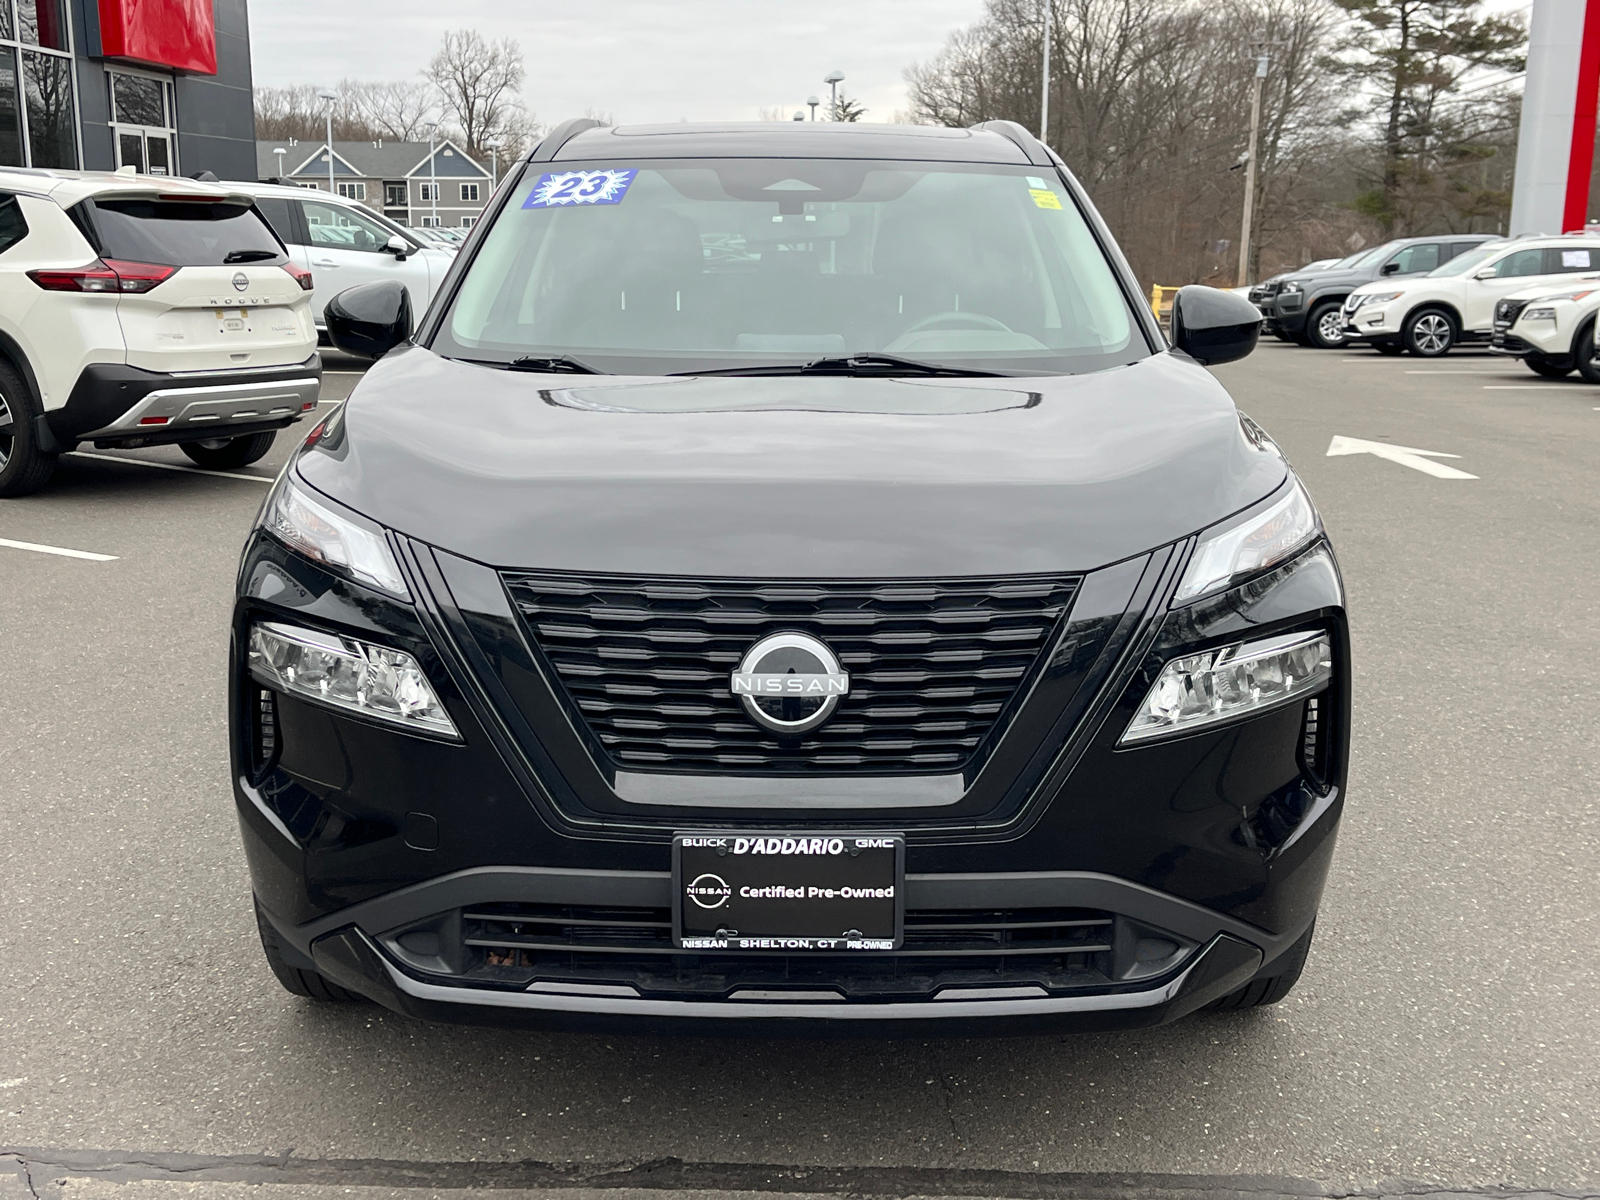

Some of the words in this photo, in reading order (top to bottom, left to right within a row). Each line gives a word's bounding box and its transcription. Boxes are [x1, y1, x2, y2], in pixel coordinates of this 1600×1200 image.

[550, 175, 609, 199] 23
[210, 296, 270, 305] ROGUE
[735, 677, 845, 692] NISSAN
[682, 838, 727, 847] BUICK
[733, 838, 844, 855] D'ADDARIO
[855, 839, 894, 848] GMC
[687, 887, 731, 895] NISSAN
[739, 886, 805, 898] Certified
[808, 885, 894, 898] Pre-Owned
[682, 940, 728, 948] NISSAN
[739, 939, 813, 950] SHELTON,
[817, 940, 838, 948] CT
[847, 941, 893, 950] PRE-OWNED
